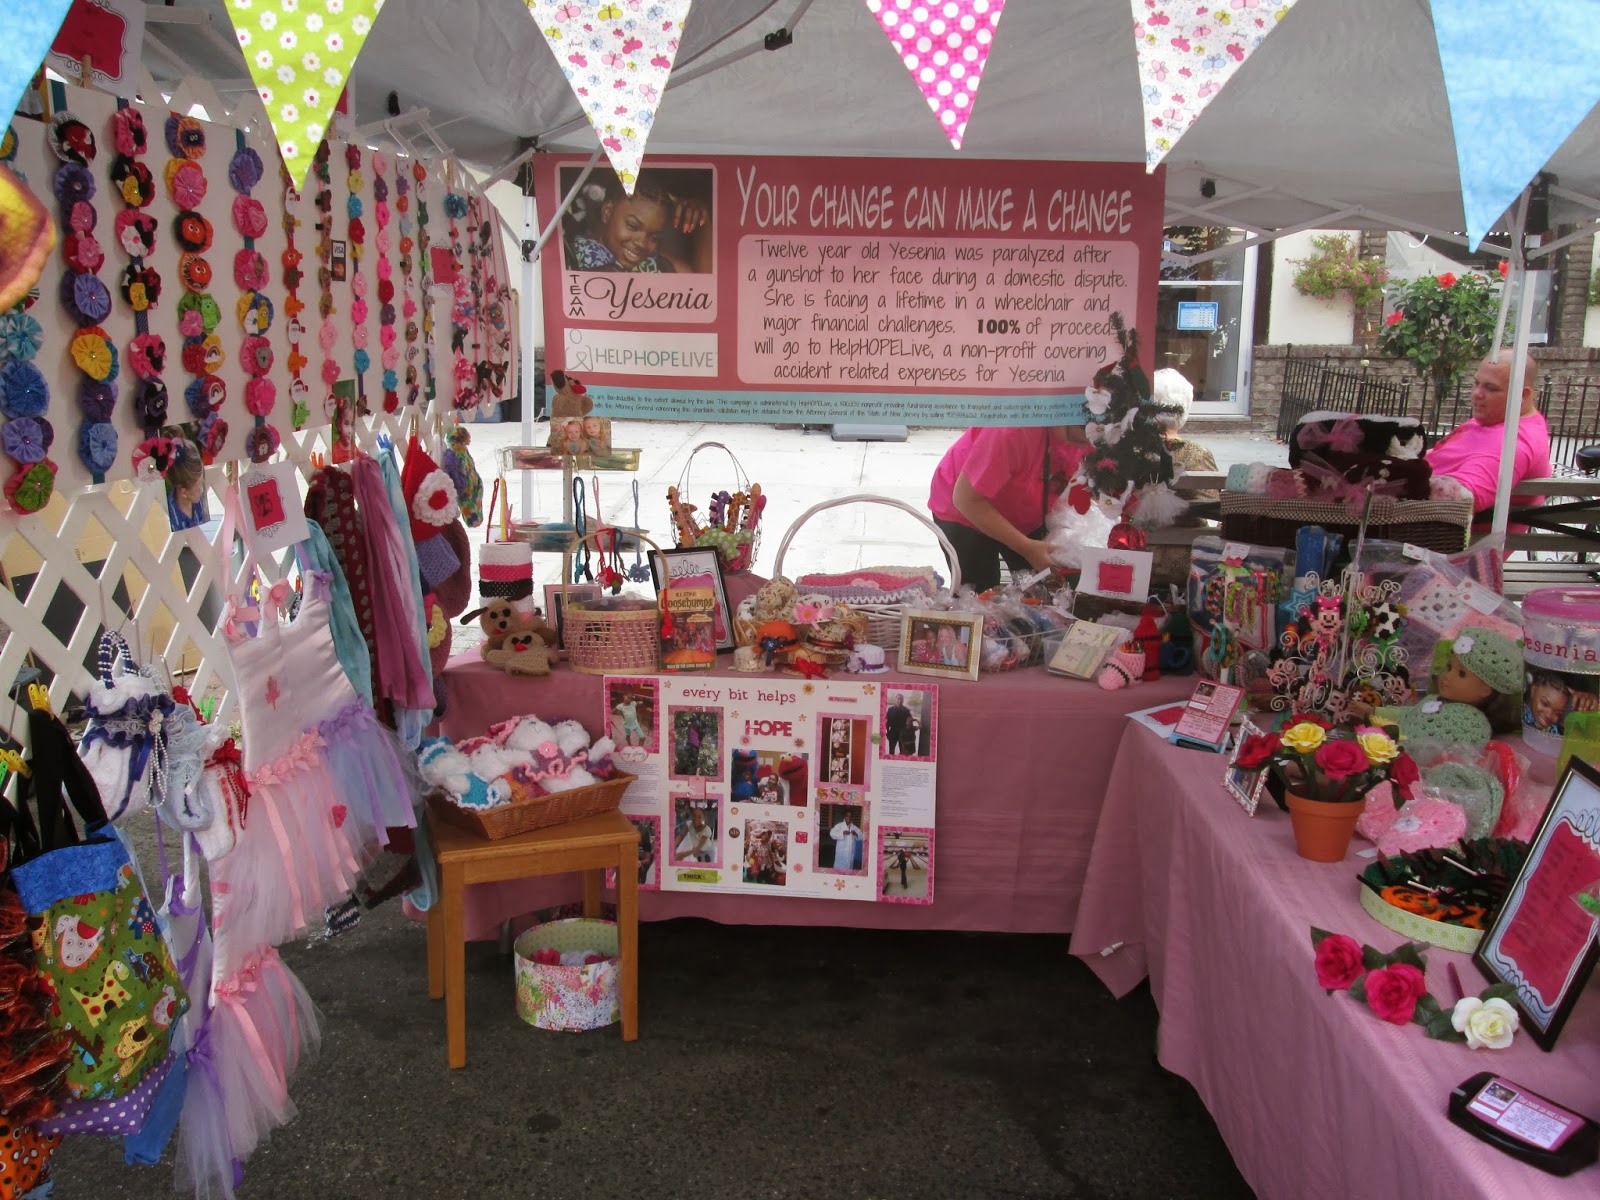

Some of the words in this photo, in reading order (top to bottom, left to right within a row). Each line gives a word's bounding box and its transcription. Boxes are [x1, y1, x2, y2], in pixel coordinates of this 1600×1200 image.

[736, 165, 800, 228] YOUR
[809, 184, 894, 230] CHANGE
[904, 186, 947, 231] CAN
[955, 186, 1015, 232] MAKE
[1022, 188, 1037, 232] A
[1047, 189, 1133, 234] CHANGE
[754, 239, 808, 259] Twelve
[818, 246, 852, 265] year
[861, 241, 880, 260] old
[889, 242, 945, 261] Yesenia
[955, 246, 983, 261] was
[992, 244, 1064, 267] paralyzed
[1073, 244, 1112, 263] after
[748, 268, 757, 282] a
[766, 265, 824, 288] gunshot
[830, 265, 844, 283] to
[853, 266, 880, 283] her
[889, 265, 923, 284] face
[932, 267, 977, 291] during
[986, 272, 995, 286] a
[1004, 268, 1065, 287] domestic
[1074, 269, 1128, 293] dispute.
[584, 276, 713, 319] Yesenia
[764, 288, 795, 307] She
[804, 289, 815, 307] is
[824, 289, 869, 314] facing
[877, 295, 887, 308] a
[896, 291, 946, 309] lifetime
[955, 292, 967, 309] in
[976, 297, 985, 309] a
[995, 293, 1075, 311] wheelchair
[1083, 293, 1110, 312] and
[763, 314, 802, 336] major
[811, 313, 869, 332] financial
[878, 314, 956, 339] challenges.
[977, 319, 1021, 335] 100%
[1025, 316, 1042, 335] of
[754, 337, 774, 355] will
[782, 340, 799, 361] go
[808, 337, 821, 356] to
[942, 344, 952, 357] a
[960, 341, 1037, 364] non-profit
[1044, 342, 1107, 364] covering
[773, 360, 833, 379] accident
[839, 362, 889, 380] related
[898, 366, 967, 386] expenses
[976, 364, 998, 382] for
[1008, 365, 1065, 382] Yesenia
[682, 687, 722, 702] every
[729, 687, 749, 701] bit
[757, 690, 796, 705] helps
[744, 719, 793, 737] HOPE
